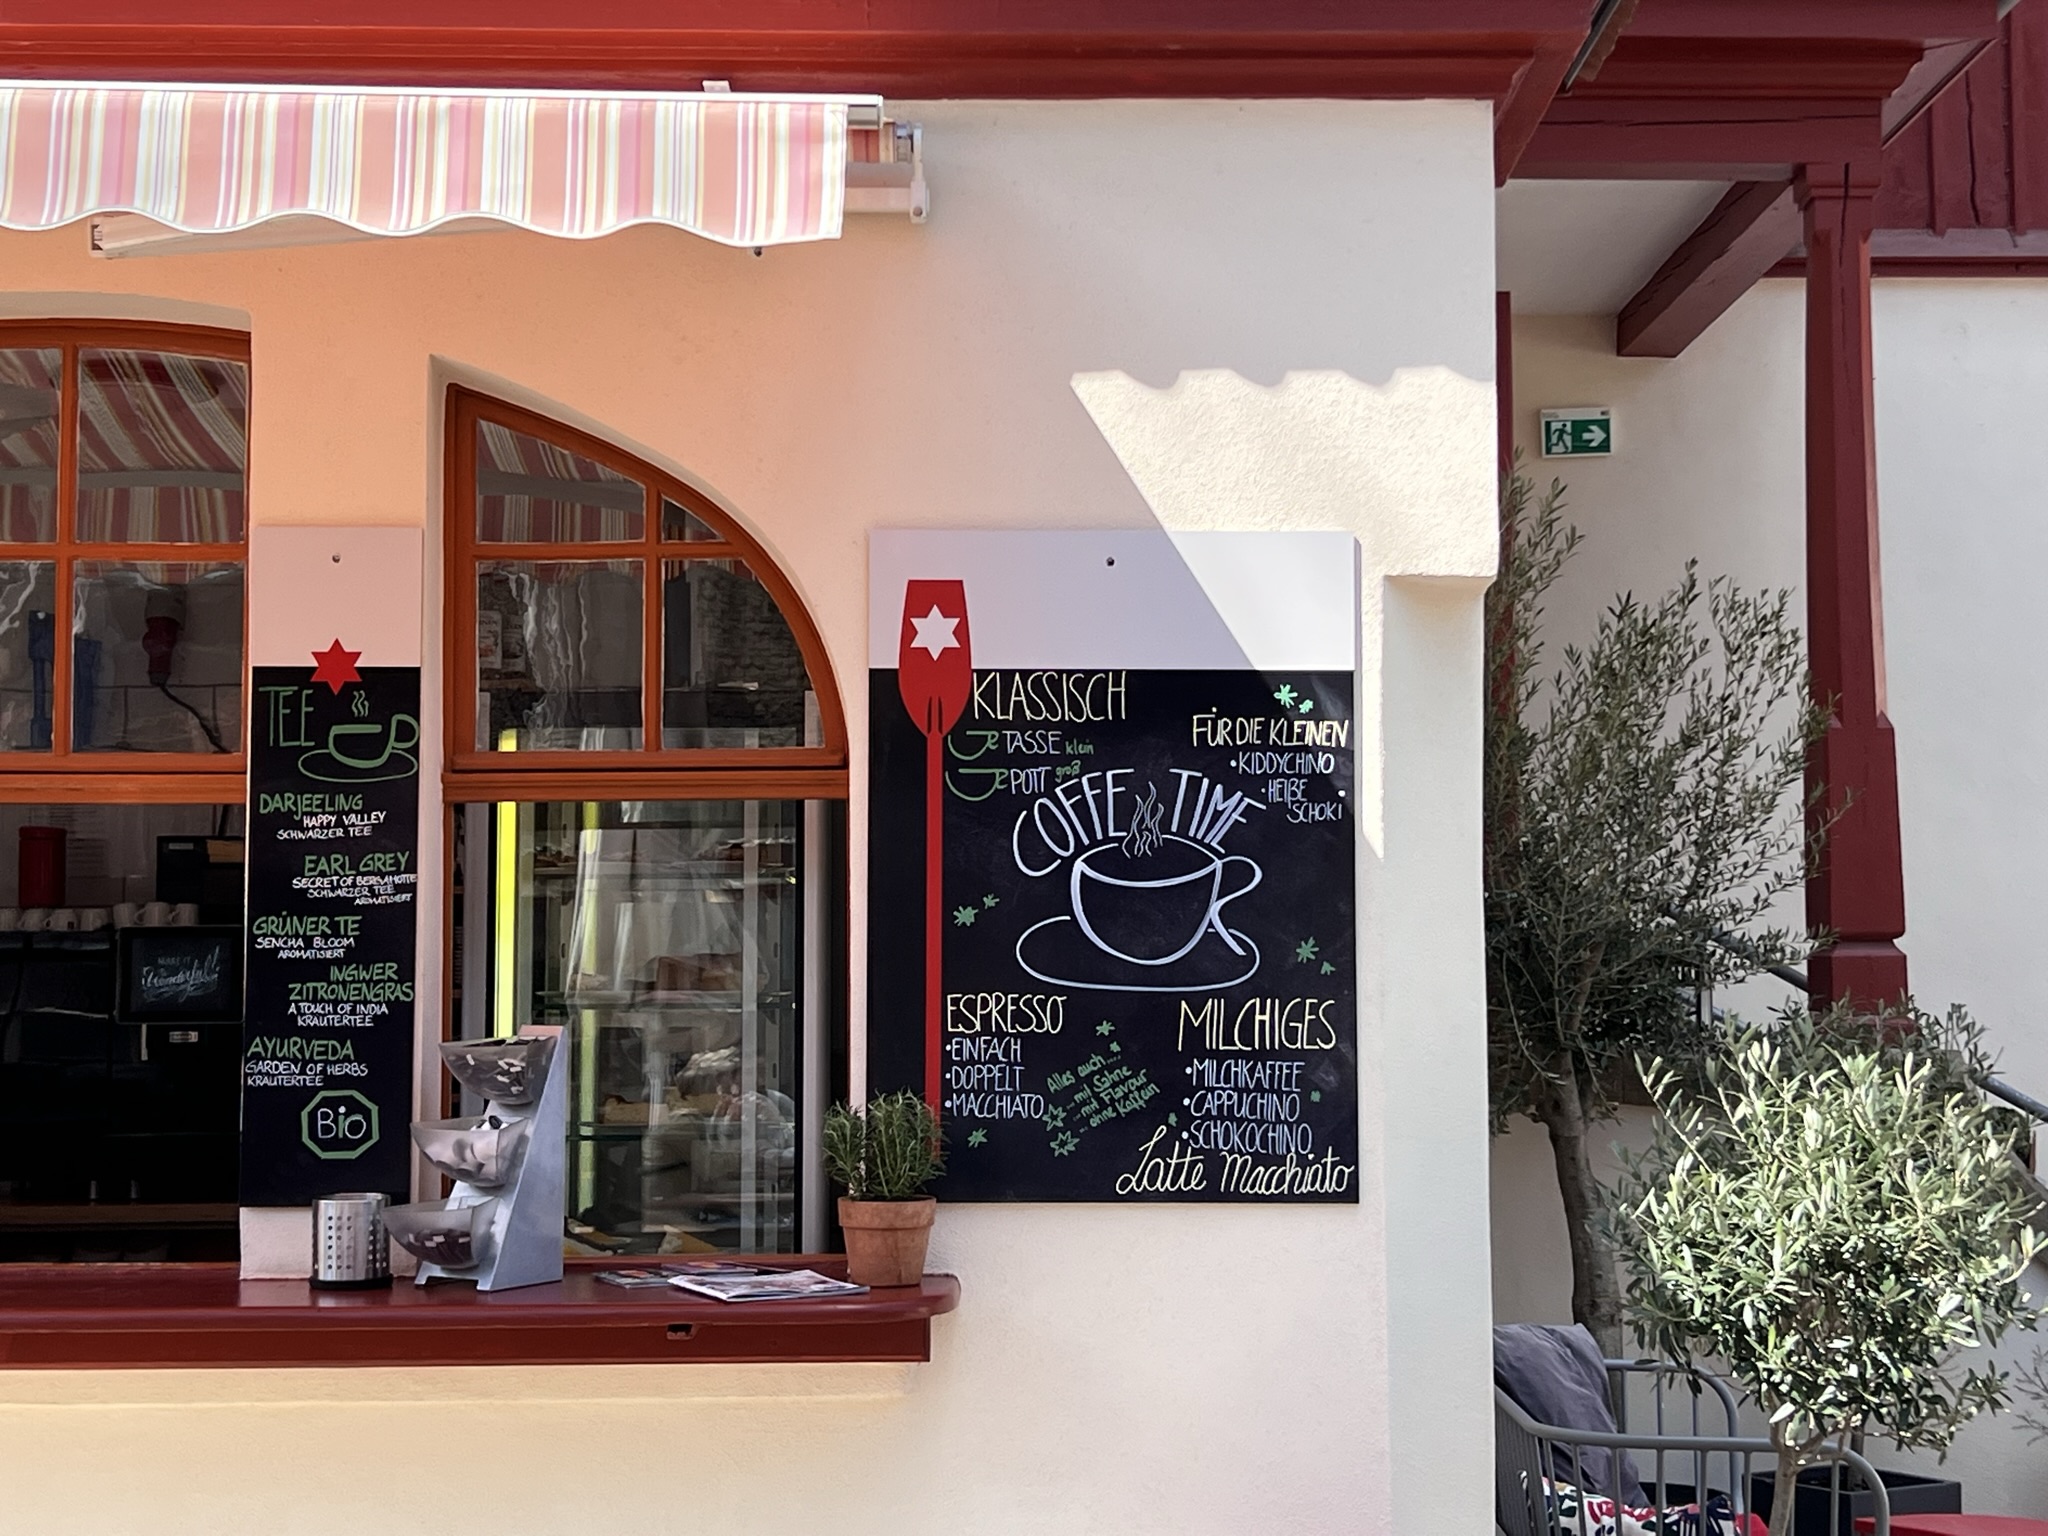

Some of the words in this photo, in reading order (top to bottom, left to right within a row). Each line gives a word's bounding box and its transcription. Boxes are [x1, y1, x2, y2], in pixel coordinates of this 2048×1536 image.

[973, 671, 1126, 722] KLASSISCH
[258, 686, 315, 746] TEE
[1193, 707, 1233, 746] FÜR
[1236, 718, 1265, 745] DIE
[1269, 719, 1349, 747] KLEINEN
[1002, 730, 1062, 754] TASSE
[1065, 738, 1094, 755] klein
[1238, 751, 1335, 775] KIDDYCHINO
[1010, 766, 1052, 795] POTT
[1055, 760, 1082, 783] groß
[259, 793, 363, 821] DARJEELING
[303, 814, 337, 828] HAPPY
[342, 811, 387, 826] VALLEY
[1169, 768, 1267, 854] TIME
[1286, 801, 1342, 824] SCHOKI
[276, 828, 344, 840] SCHWARZER
[348, 826, 373, 836] TEE
[304, 854, 356, 877] EARL
[359, 851, 410, 873] GREY
[292, 875, 340, 889] SECRET
[340, 876, 354, 887] OF
[307, 886, 371, 898] SCHWARZER
[373, 885, 396, 895] TEE
[252, 911, 332, 936] GRÜNER
[334, 915, 362, 936] TE
[255, 937, 305, 949] SENCHA
[313, 936, 355, 948] BLOOM
[277, 948, 346, 960] AROMATISIERT
[330, 962, 398, 982] INGWER
[288, 982, 415, 1003] ZITRONENGRAS
[287, 1002, 297, 1015] A
[299, 1003, 333, 1014] TOUCH
[337, 1003, 353, 1014] OF
[356, 1003, 389, 1015] INDIA
[947, 992, 1068, 1034] ESPRESSO
[1178, 997, 1337, 1052] MILCHIGES
[247, 1036, 355, 1061] AYURVEDA
[951, 1036, 1022, 1063] EINFACH
[244, 1060, 302, 1075] GARDEN
[306, 1063, 325, 1075] OF
[327, 1062, 369, 1077] HERBS
[951, 1065, 1026, 1091] DOPPELT
[1093, 1066, 1133, 1093] Sahne
[1192, 1058, 1306, 1092] MILCHKAFFEE
[1046, 1070, 1076, 1094] Alles
[1100, 1069, 1147, 1105] Flavour
[953, 1092, 1044, 1120] MACCHIATO
[1190, 1090, 1300, 1122] CAPPUCHINO
[317, 1105, 367, 1139] Bio
[1190, 1120, 1313, 1156] SCHOKOCHINO
[1115, 1125, 1207, 1195] Latte
[1219, 1146, 1356, 1196] Macchiato
